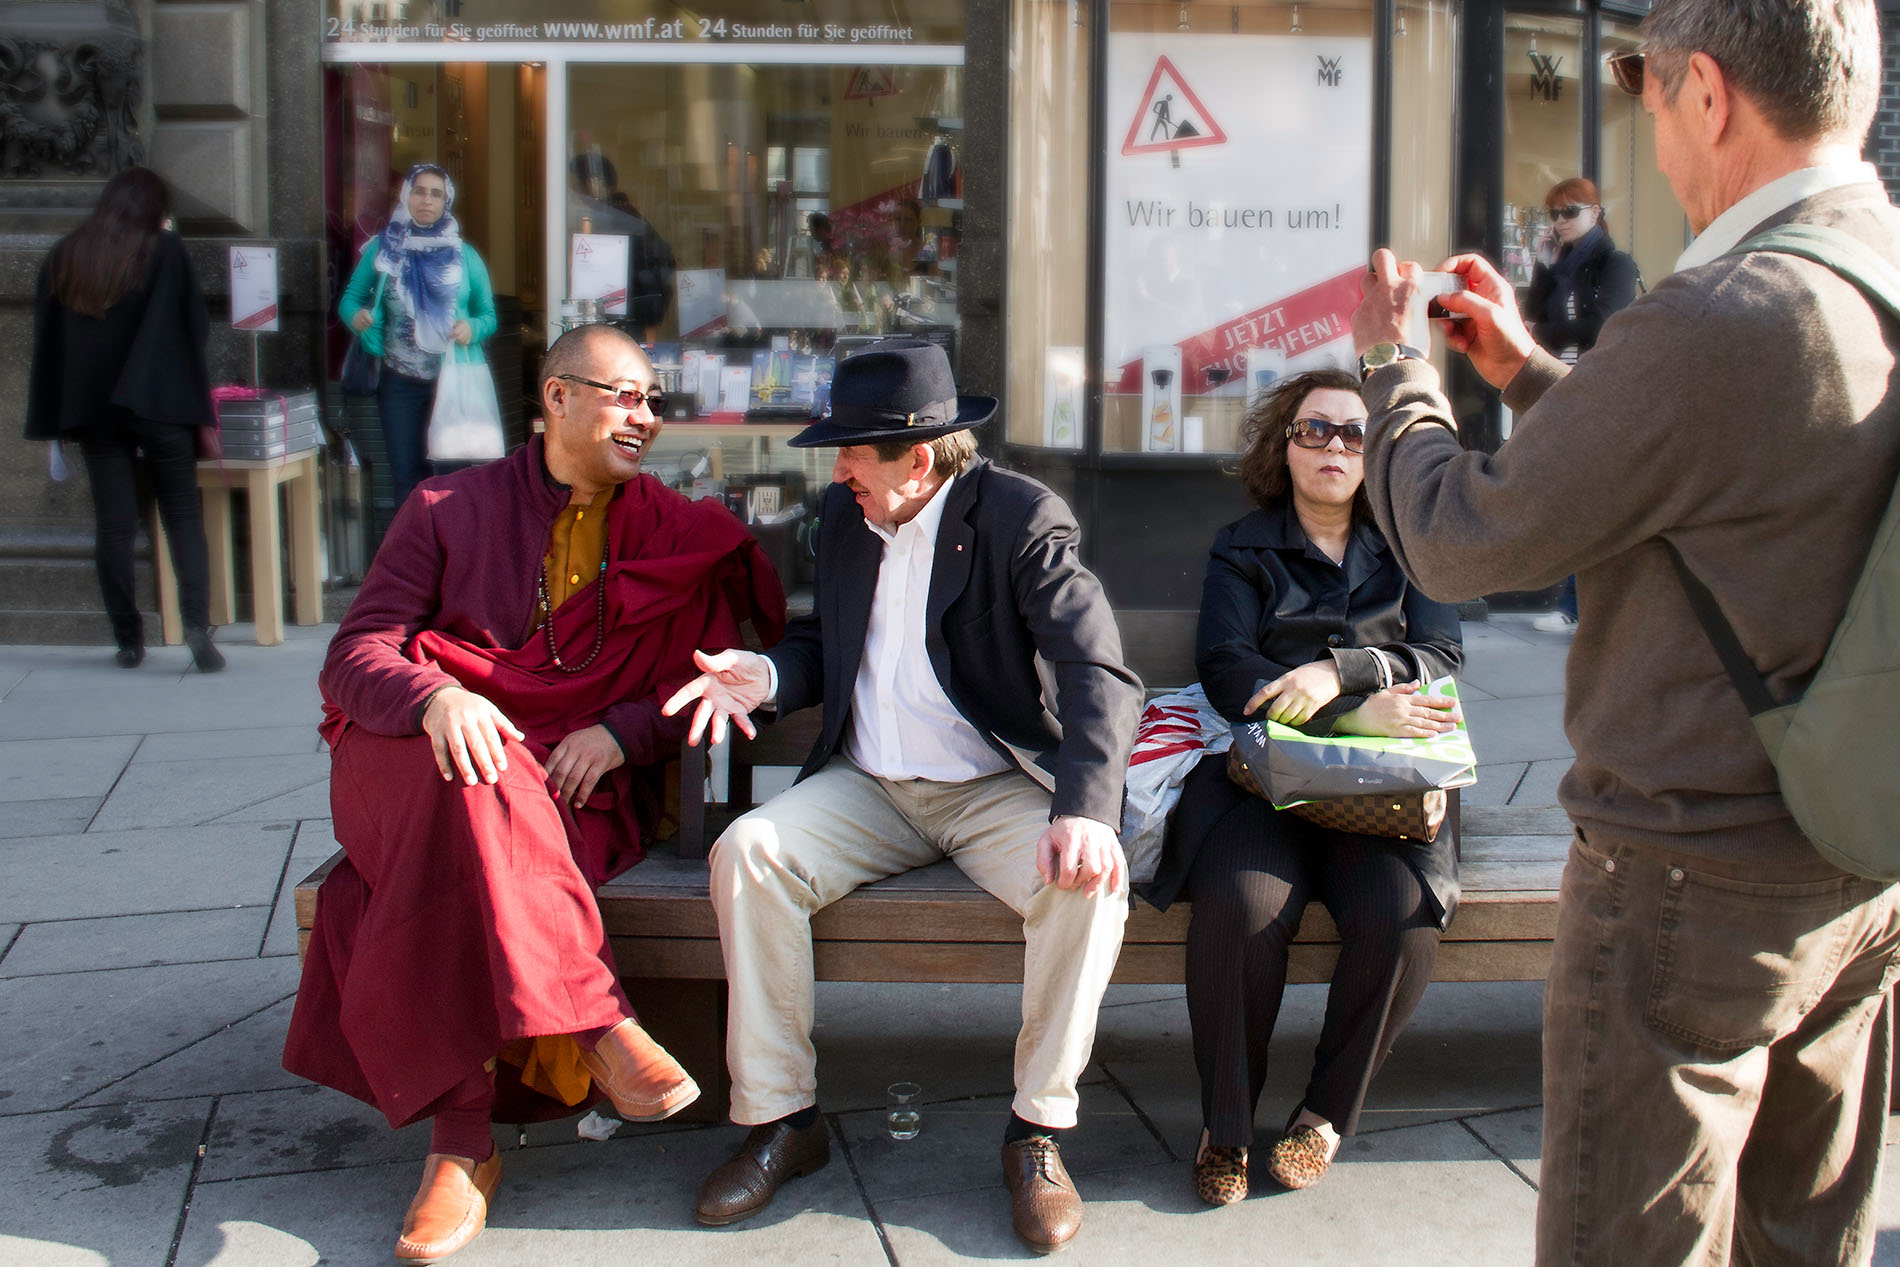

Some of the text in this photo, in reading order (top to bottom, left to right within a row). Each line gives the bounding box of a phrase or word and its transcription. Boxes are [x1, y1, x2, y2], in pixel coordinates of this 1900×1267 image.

[327, 17, 913, 42] 24 Stunden für Sie geöffnet www.wmf.at 24 Stunden für Sie geöffnet
[1126, 200, 1342, 230] Wir bauen um!
[1223, 306, 1287, 351] JETZT
